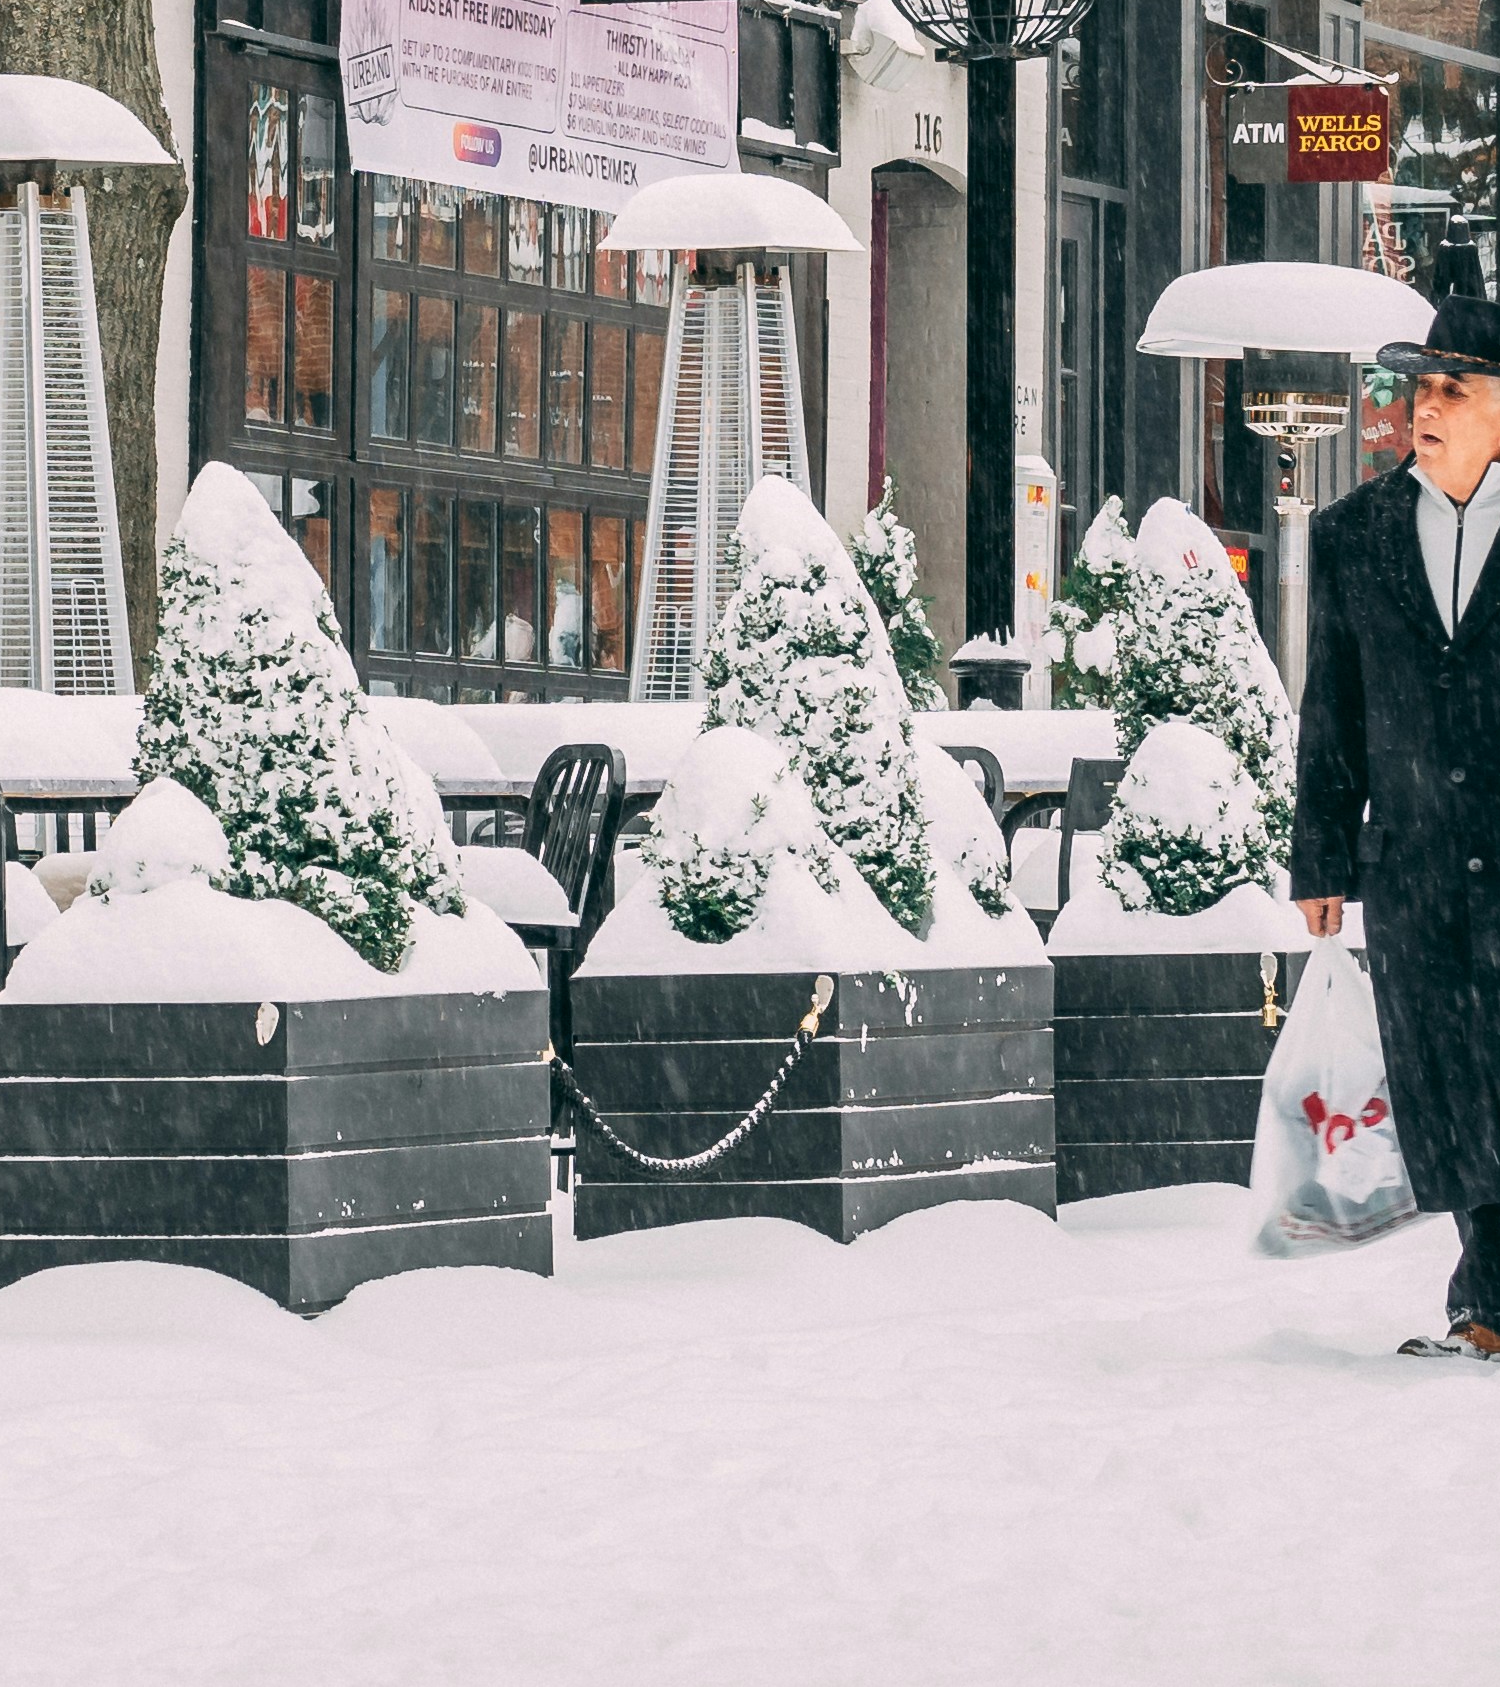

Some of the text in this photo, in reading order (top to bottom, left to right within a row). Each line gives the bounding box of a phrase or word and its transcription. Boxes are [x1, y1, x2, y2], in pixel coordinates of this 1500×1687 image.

[462, 0, 488, 25] FREE
[491, 4, 557, 39] WEDNESDAY
[606, 29, 648, 59] THIRSTY
[351, 51, 391, 90] URBANO
[401, 38, 418, 57] GET
[419, 42, 430, 59] UP
[433, 45, 445, 62] TO
[444, 47, 450, 63] 2
[534, 63, 557, 84] ITEMS
[618, 61, 629, 78] ALL
[631, 63, 648, 81] DAY
[648, 68, 673, 86] HAPPY
[401, 62, 533, 100] WITH THE PURCHASE OF AN ENTREE
[582, 75, 625, 97] APPETIZERS
[567, 113, 707, 156] $6 YUENGLING DRAFT AND HOUSE WINES
[662, 112, 690, 130] SELECT
[690, 118, 727, 140] COCKTAILS
[914, 111, 943, 154] 116
[1232, 123, 1381, 152] ATM FARGO
[1297, 114, 1382, 132] WELLS
[460, 133, 495, 154] FOLLOW US
[528, 143, 639, 188] @URBANOTEXMEX
[1016, 385, 1038, 406] CAN
